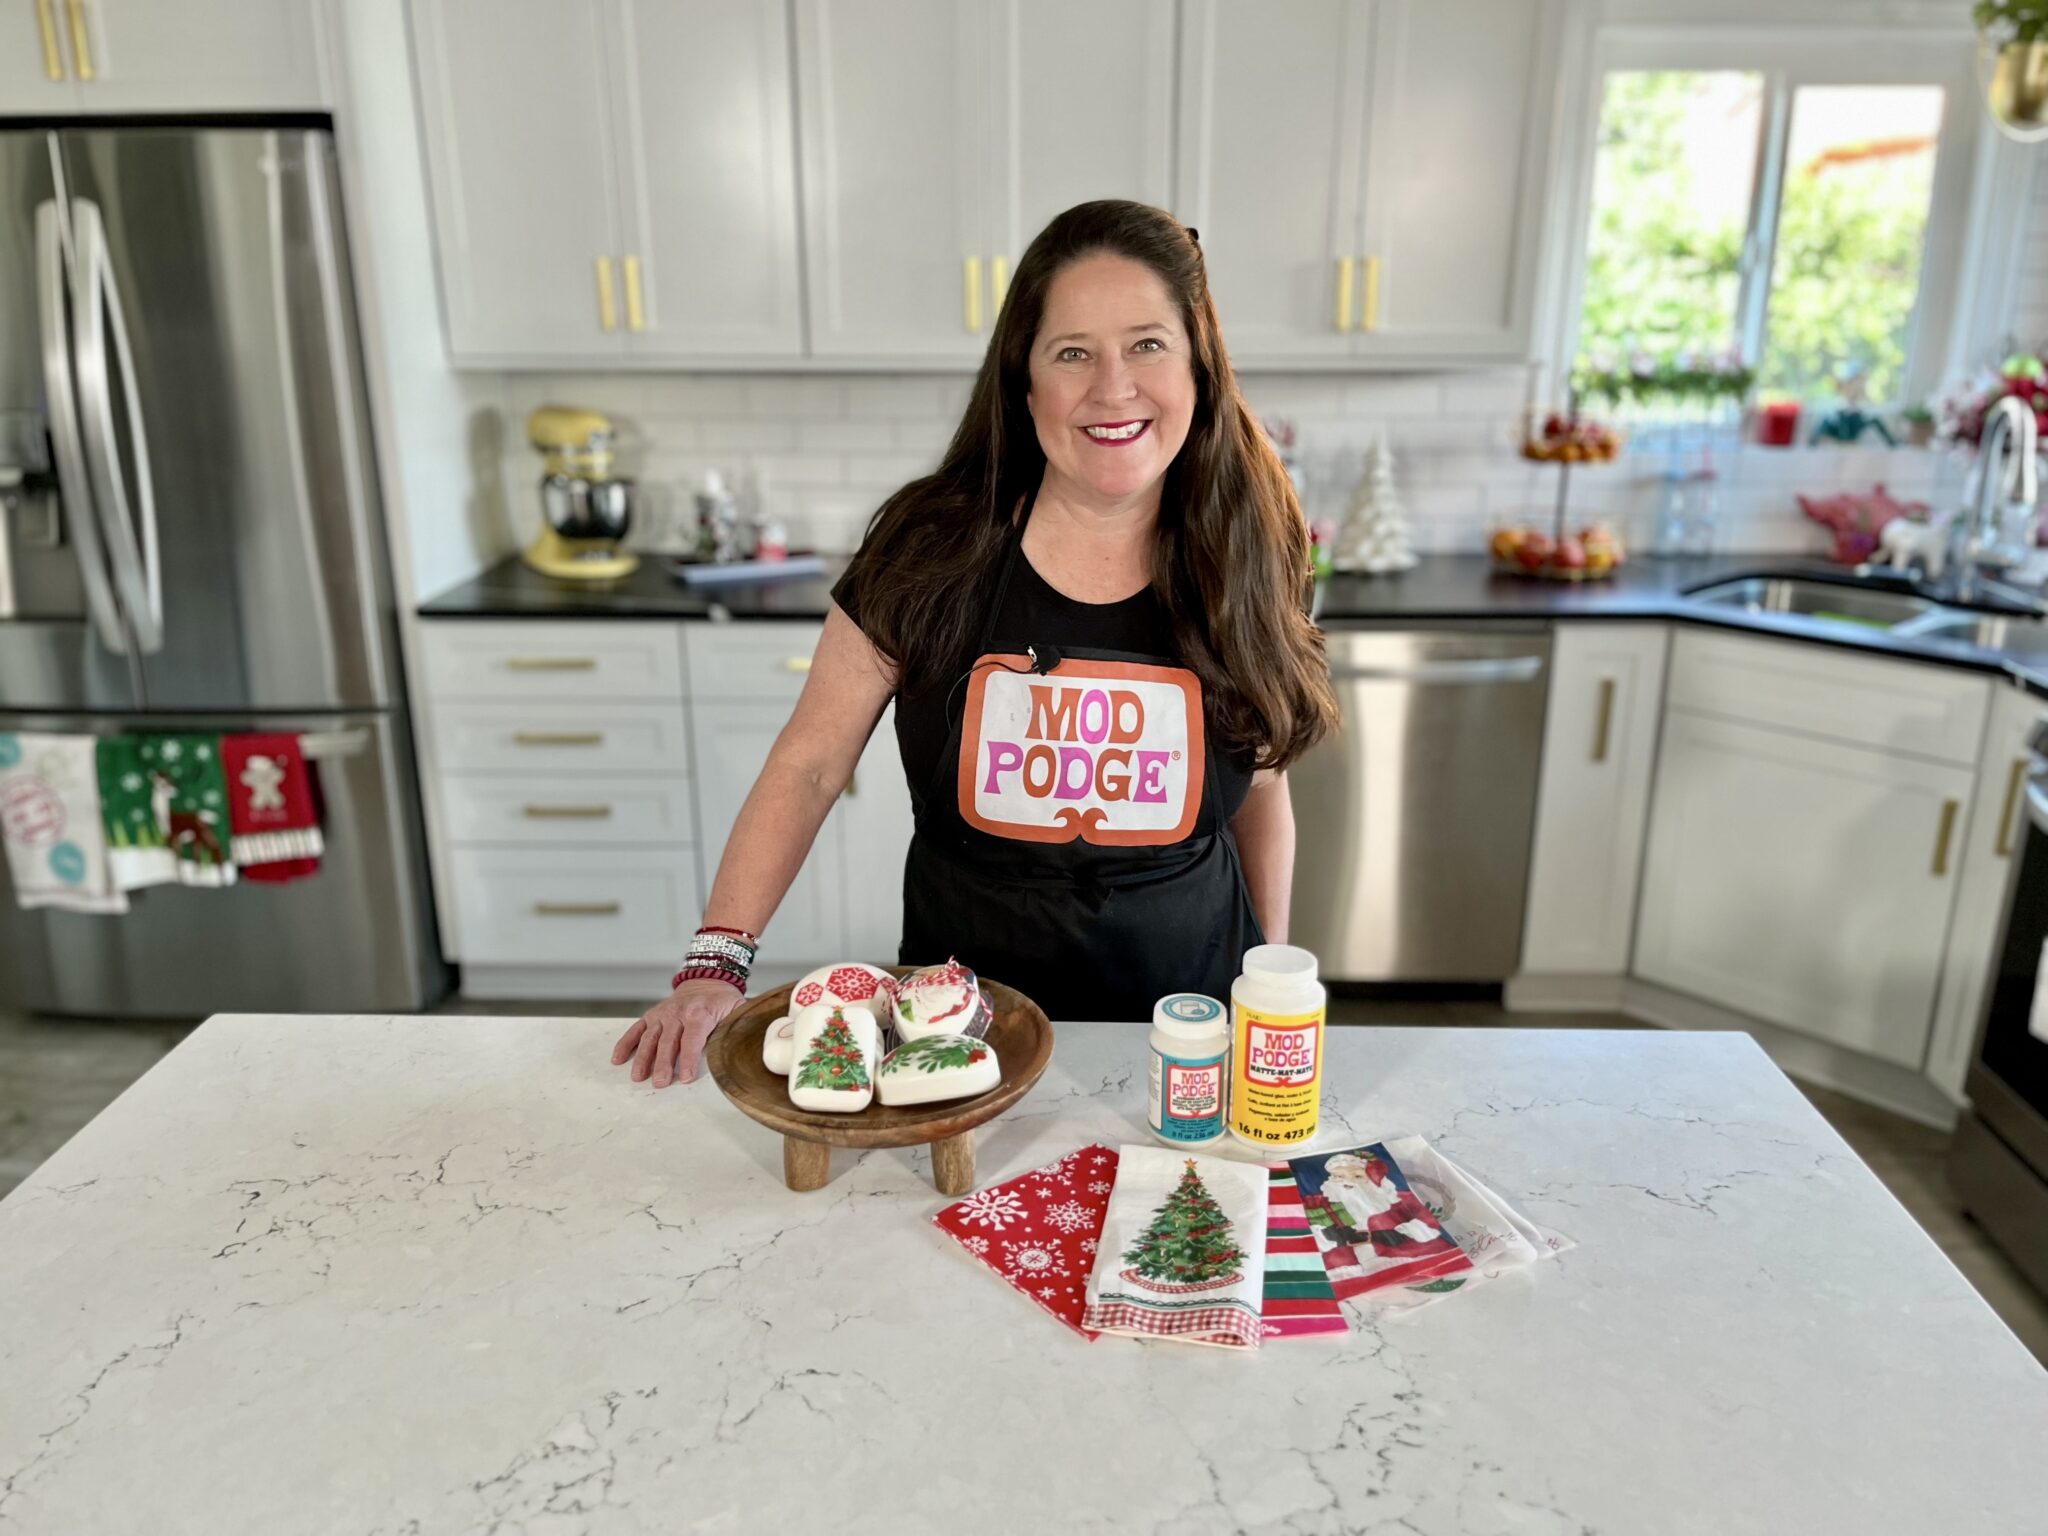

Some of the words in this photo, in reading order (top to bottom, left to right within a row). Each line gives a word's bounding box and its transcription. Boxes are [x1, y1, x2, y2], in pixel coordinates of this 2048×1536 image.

[1025, 685, 1145, 744] MOD
[1264, 1033, 1304, 1050] MOD
[1252, 1047, 1310, 1067] PODGE
[1181, 1072, 1209, 1085] MOD
[1172, 1083, 1215, 1097] PODGE
[1239, 1122, 1250, 1134] 16
[1253, 1128, 1262, 1138] fl
[1284, 1129, 1304, 1140] 473
